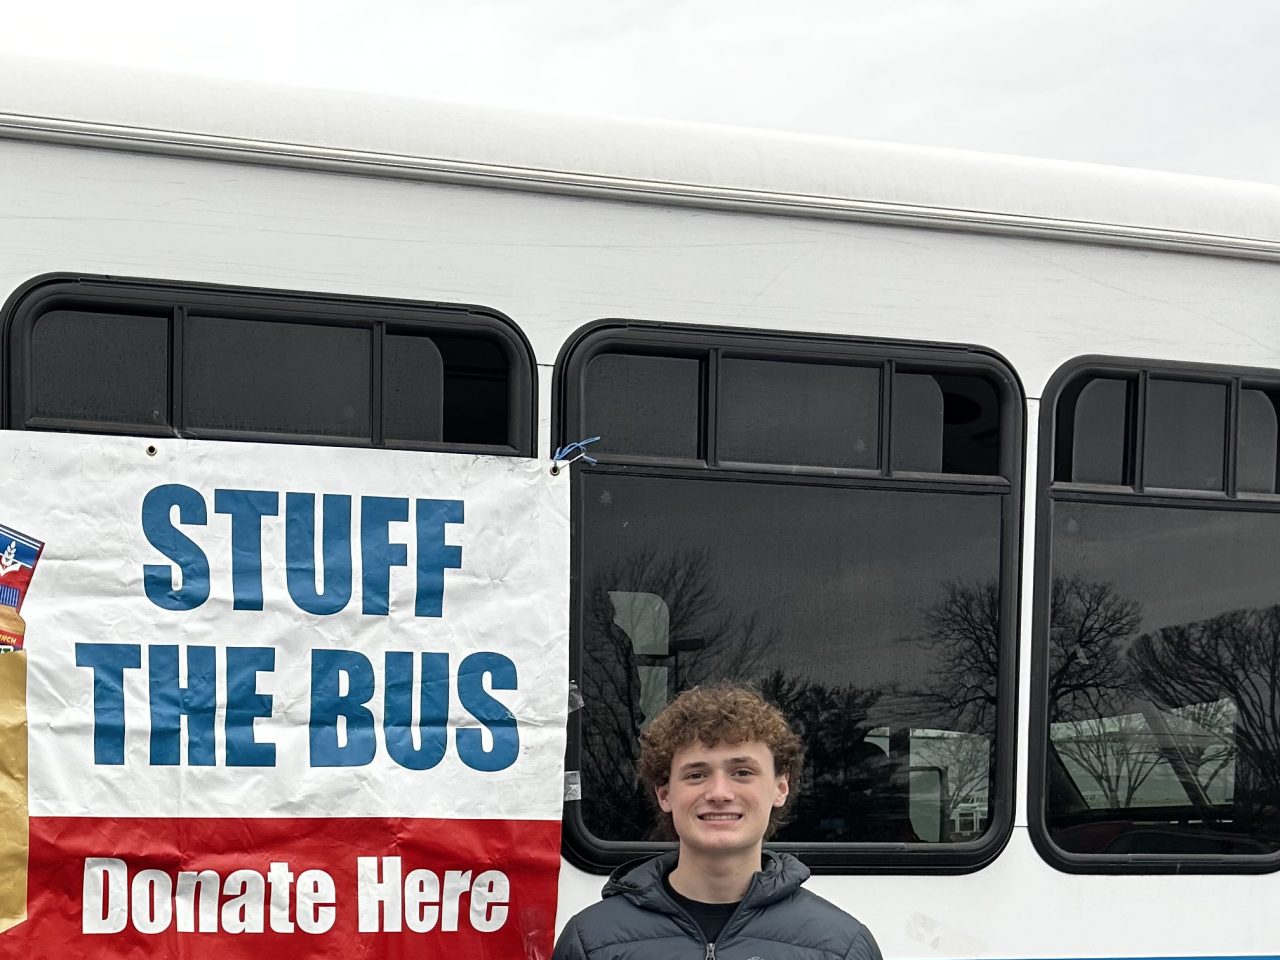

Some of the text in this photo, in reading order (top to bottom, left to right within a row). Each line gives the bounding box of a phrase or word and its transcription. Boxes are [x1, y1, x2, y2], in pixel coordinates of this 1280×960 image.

[141, 483, 465, 618] STUFF
[75, 642, 520, 773] THE BUS
[81, 855, 510, 935] Donate Here
